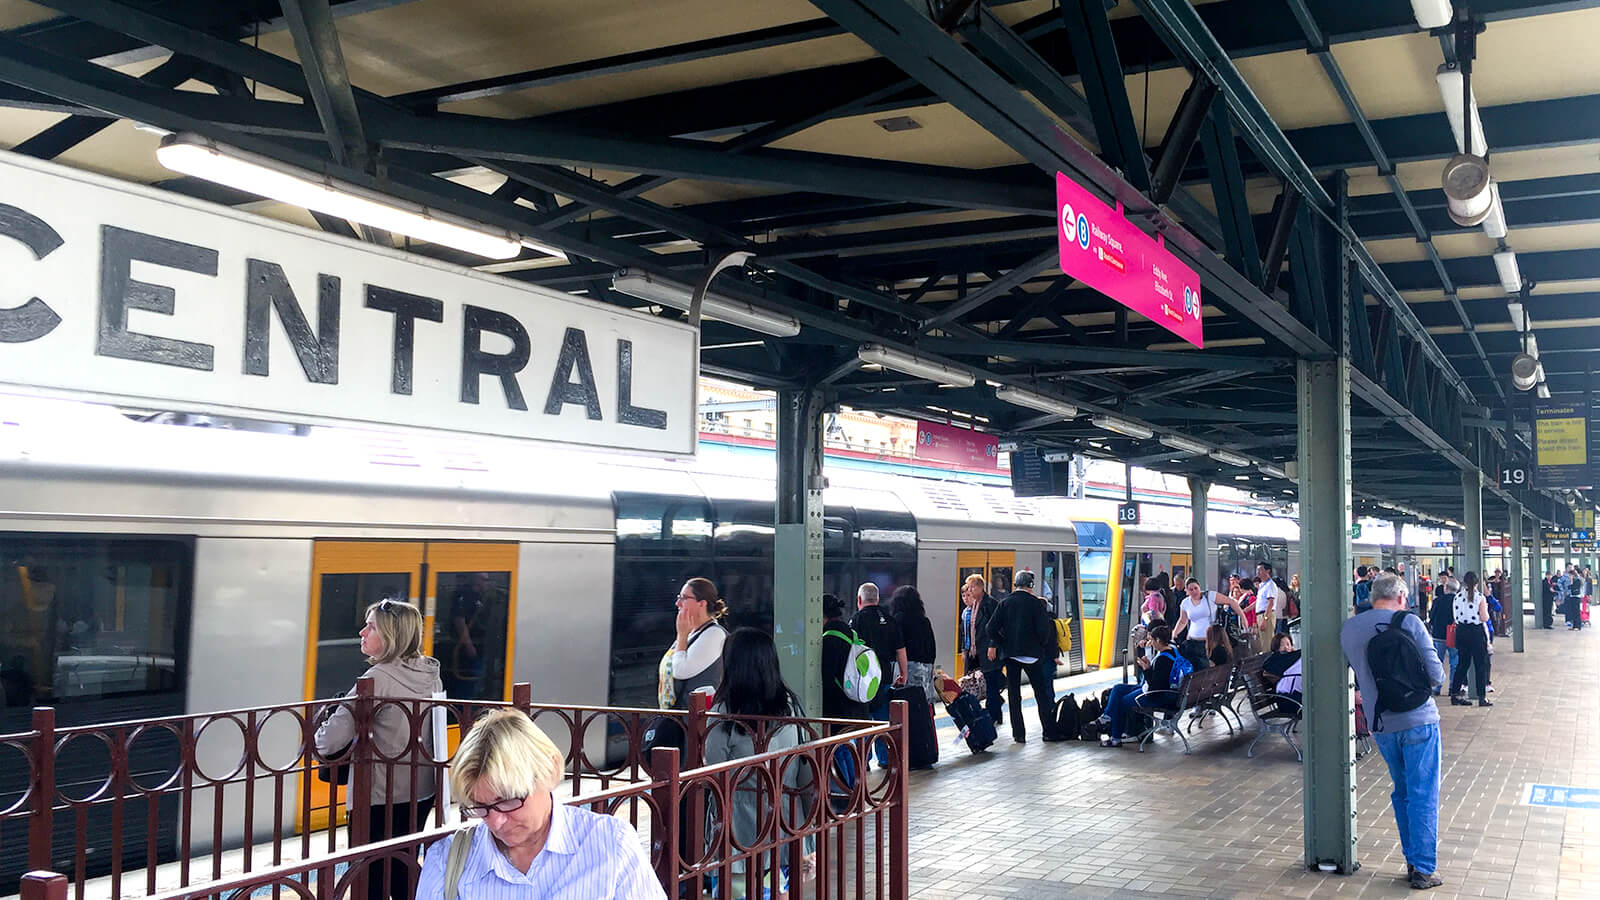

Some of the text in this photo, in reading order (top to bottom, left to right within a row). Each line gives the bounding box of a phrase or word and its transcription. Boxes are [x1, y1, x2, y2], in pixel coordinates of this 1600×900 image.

[1536, 407, 1575, 415] Terminates
[1502, 469, 1525, 484] 19
[1119, 508, 1136, 521] 18
